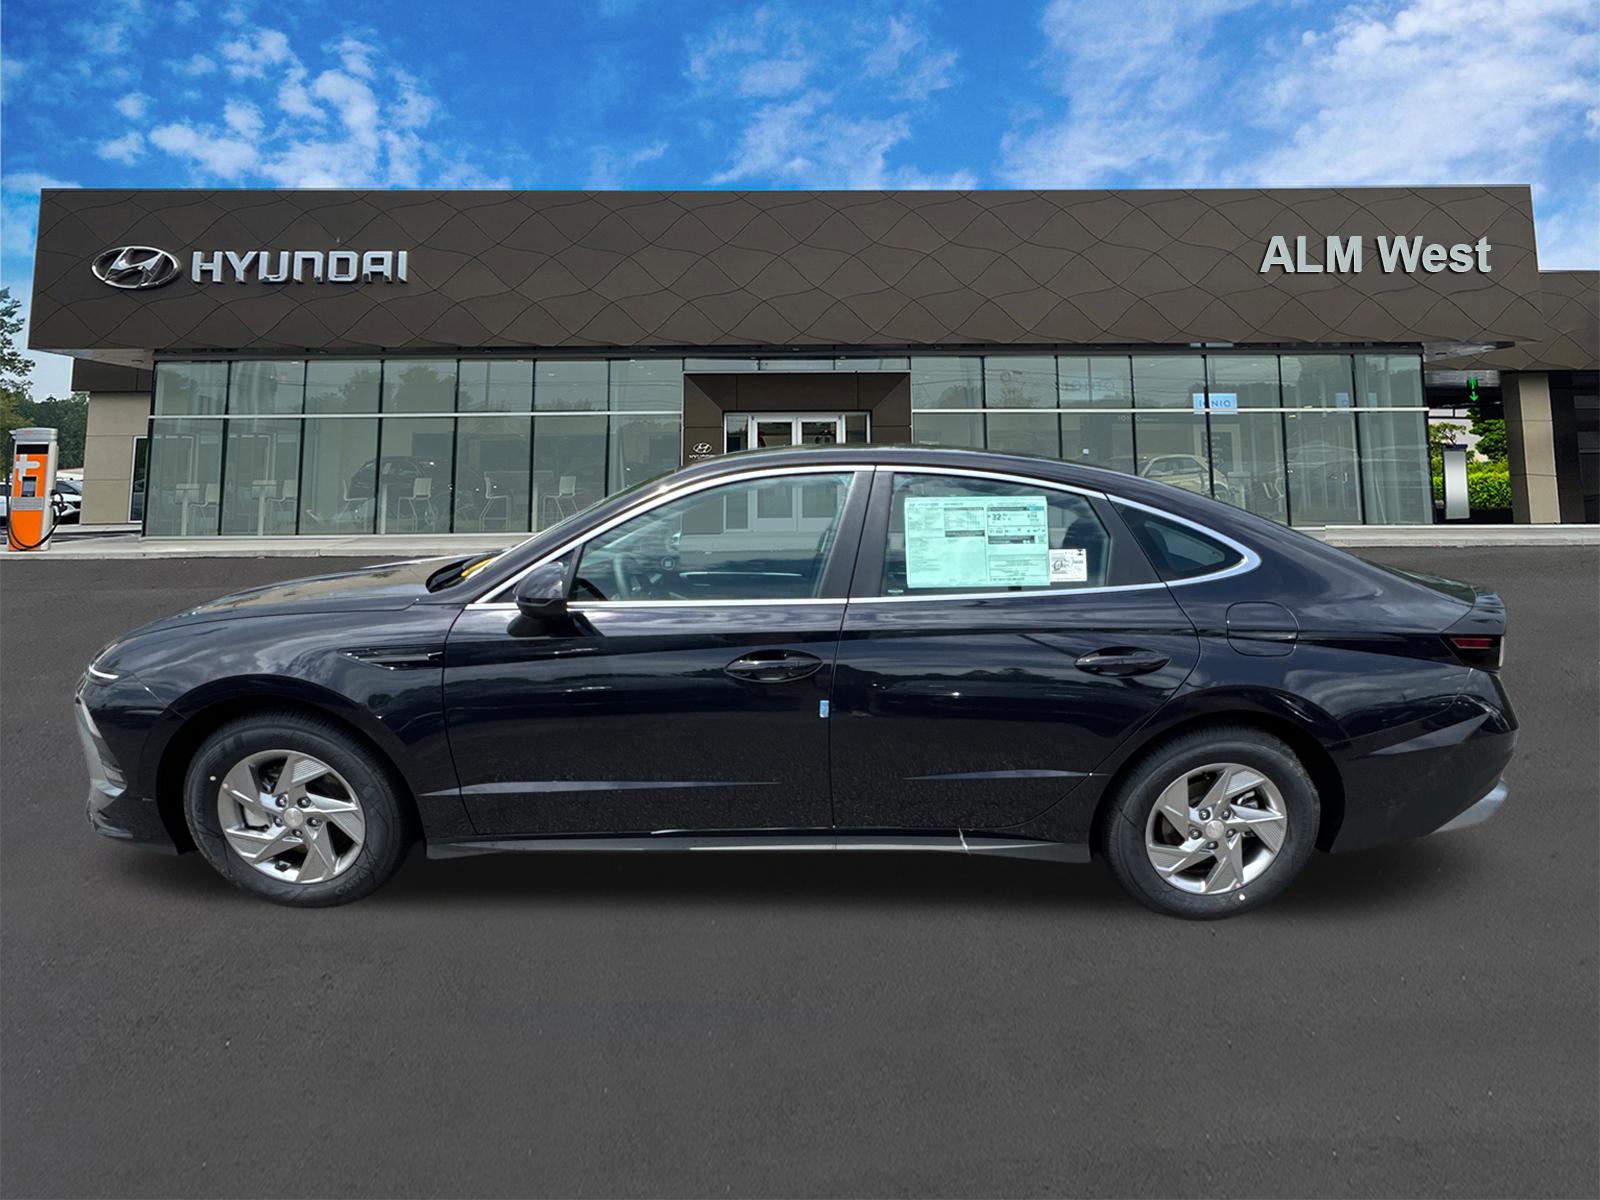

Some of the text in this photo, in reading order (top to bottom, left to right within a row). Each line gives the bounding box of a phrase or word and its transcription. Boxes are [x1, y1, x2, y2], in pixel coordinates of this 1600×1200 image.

[191, 250, 409, 284] HYUNDAI
[1259, 235, 1492, 273] ALM West
